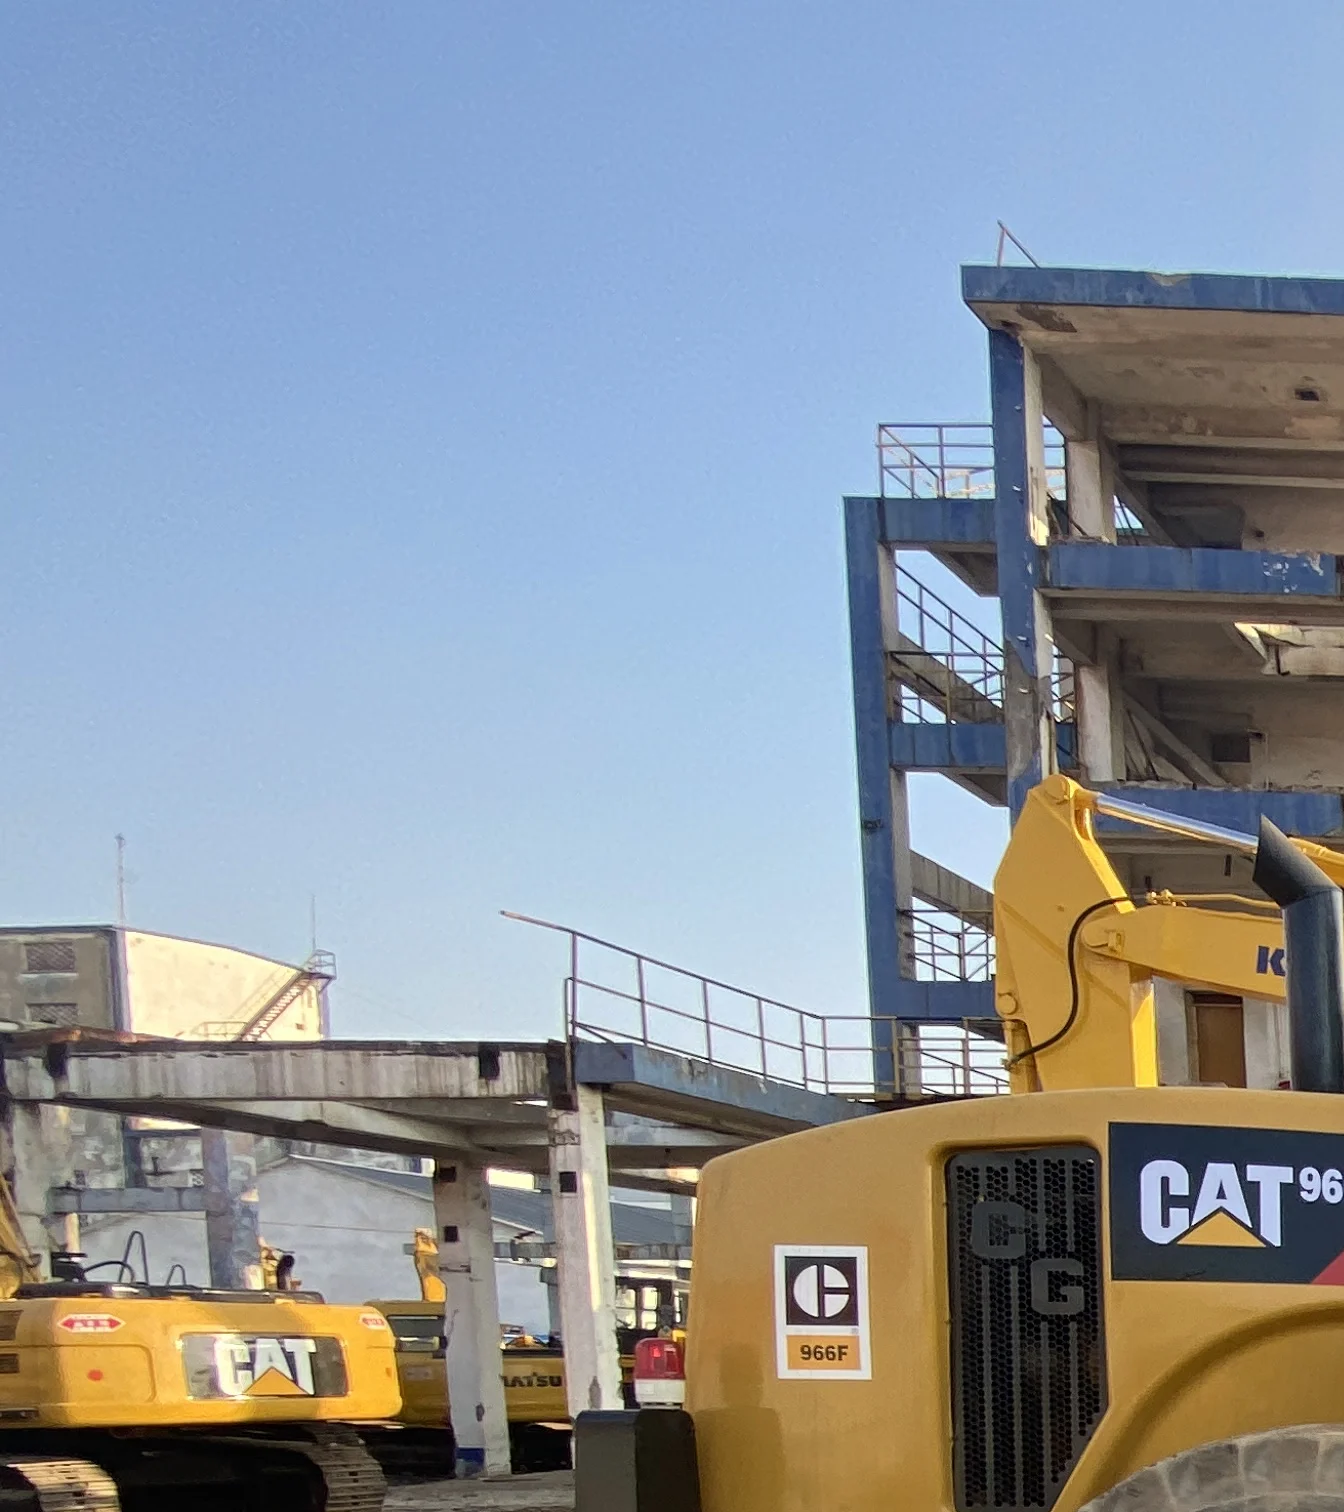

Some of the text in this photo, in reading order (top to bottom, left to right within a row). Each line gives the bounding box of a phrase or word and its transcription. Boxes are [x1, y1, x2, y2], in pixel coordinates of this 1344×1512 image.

[1140, 1160, 1294, 1247] CAT
[212, 1336, 318, 1396] CAT
[800, 1344, 849, 1361] 966F
[501, 1372, 563, 1388] ATSU
